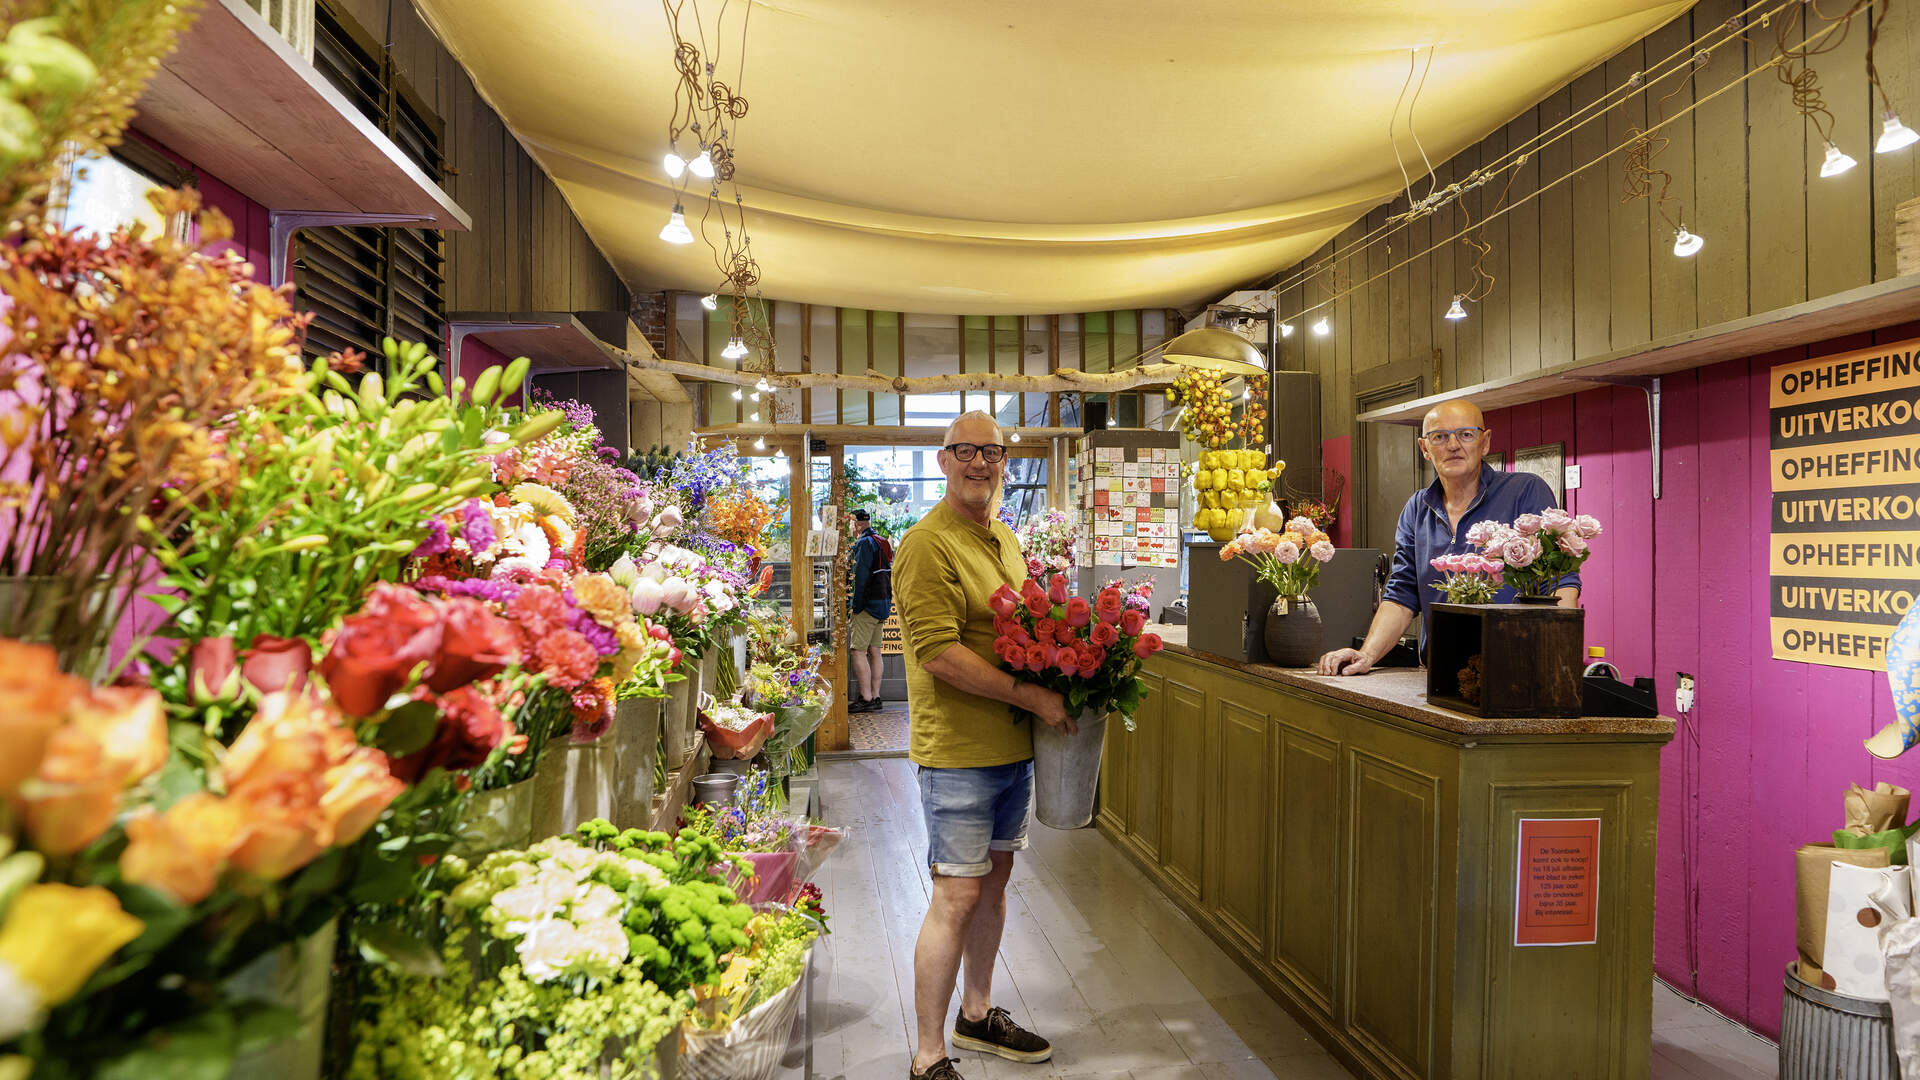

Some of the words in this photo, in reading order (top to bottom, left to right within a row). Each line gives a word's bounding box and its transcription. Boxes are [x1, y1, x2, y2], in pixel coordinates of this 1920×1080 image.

[1781, 448, 1920, 480] OPHEFFIN
[1782, 495, 1920, 523] UITVERKO
[1783, 544, 1920, 566] OPHEFFIN
